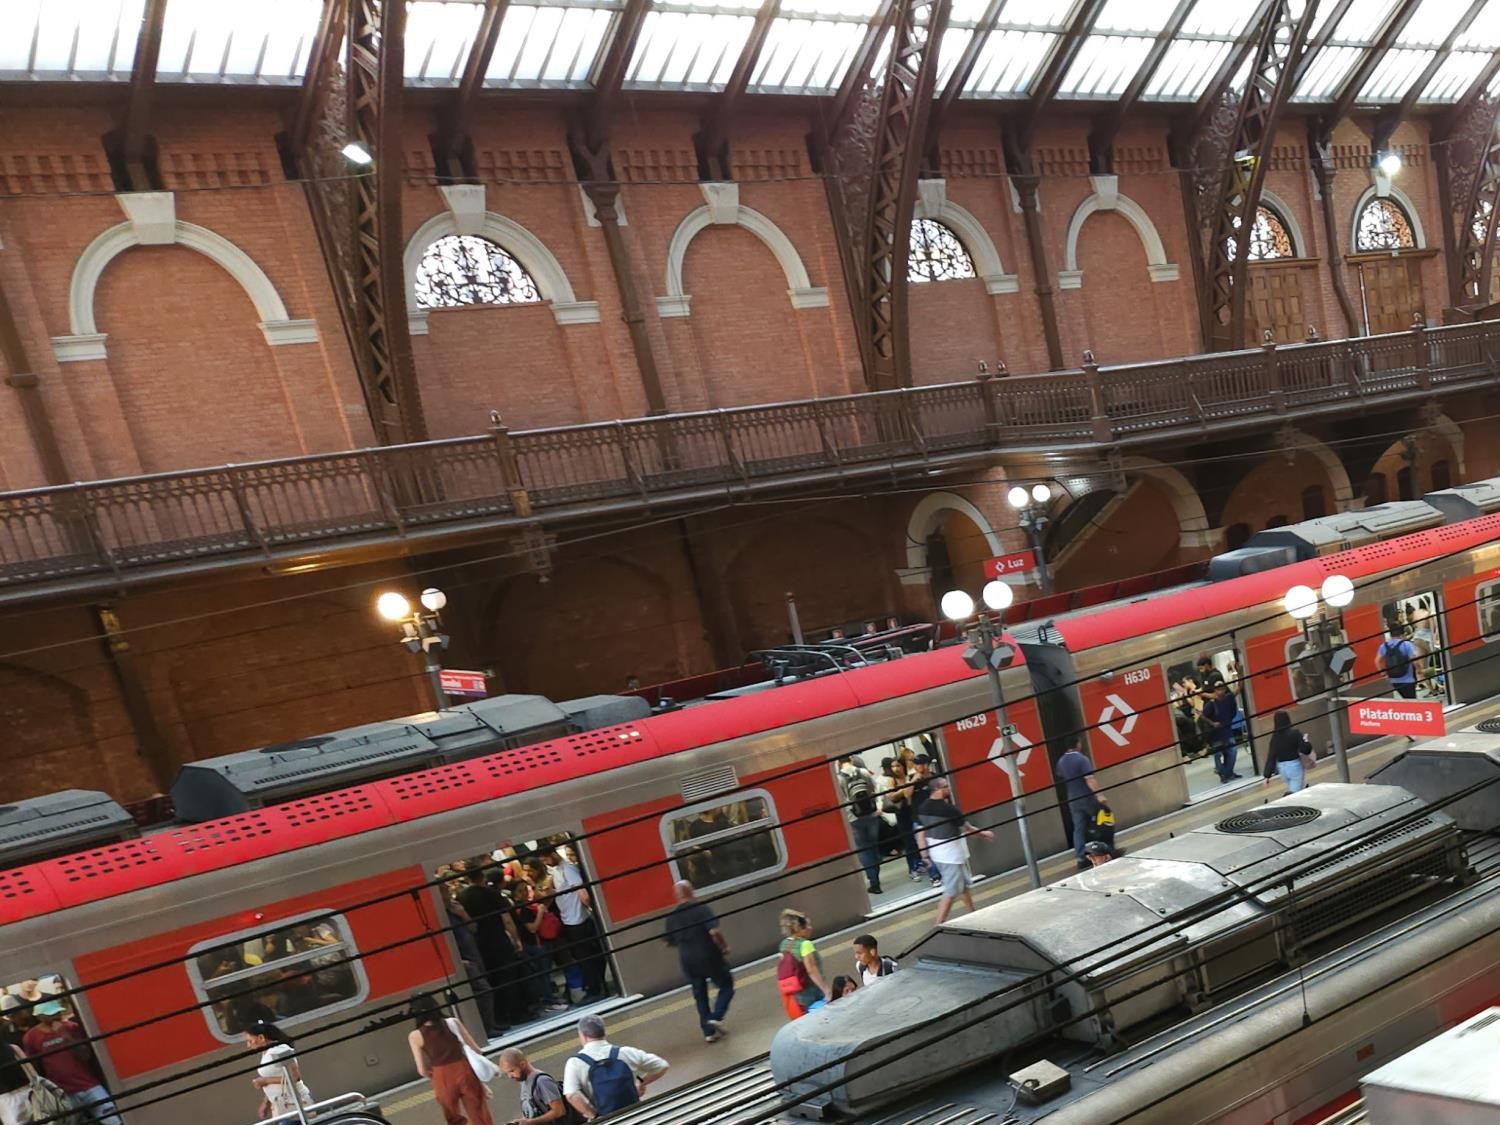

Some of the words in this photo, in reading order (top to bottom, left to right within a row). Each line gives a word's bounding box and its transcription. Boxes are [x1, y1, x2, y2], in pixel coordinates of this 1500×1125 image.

[1008, 558, 1024, 569] Luz
[1124, 668, 1150, 686] H630
[956, 713, 987, 732] H629
[1359, 708, 1423, 721] Plataforma
[1424, 711, 1433, 722] 3
